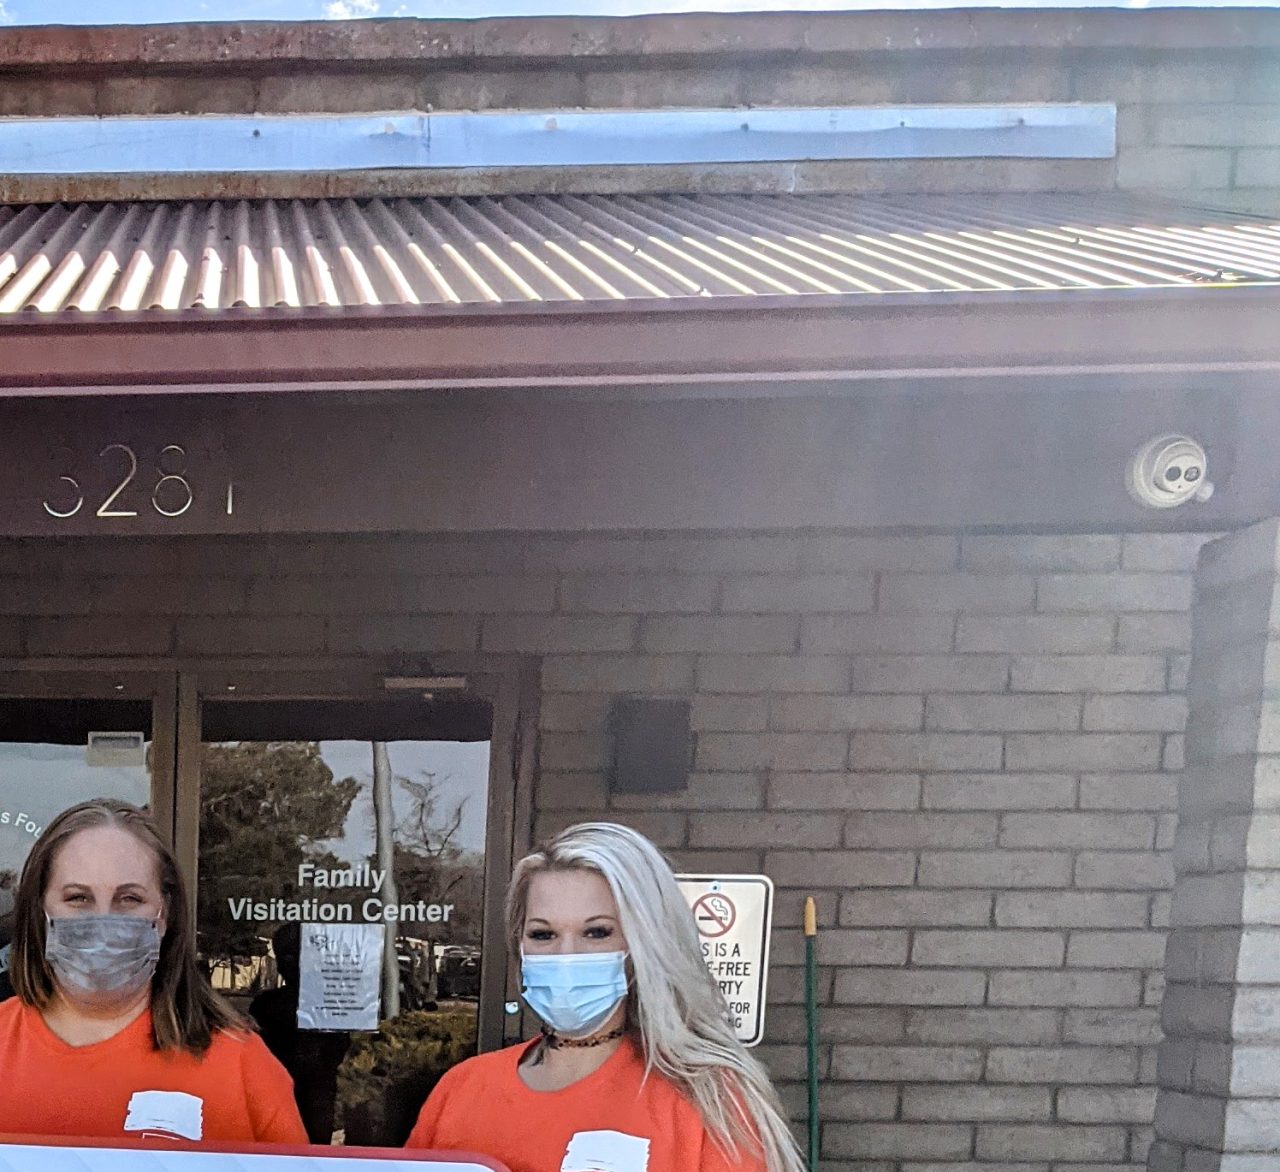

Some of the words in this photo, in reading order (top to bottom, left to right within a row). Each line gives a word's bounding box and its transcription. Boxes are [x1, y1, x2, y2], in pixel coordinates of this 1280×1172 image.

[297, 863, 387, 892] Family
[227, 897, 353, 922] Visitation
[362, 898, 455, 922] Center
[714, 942, 727, 957] IS
[731, 943, 741, 957] A
